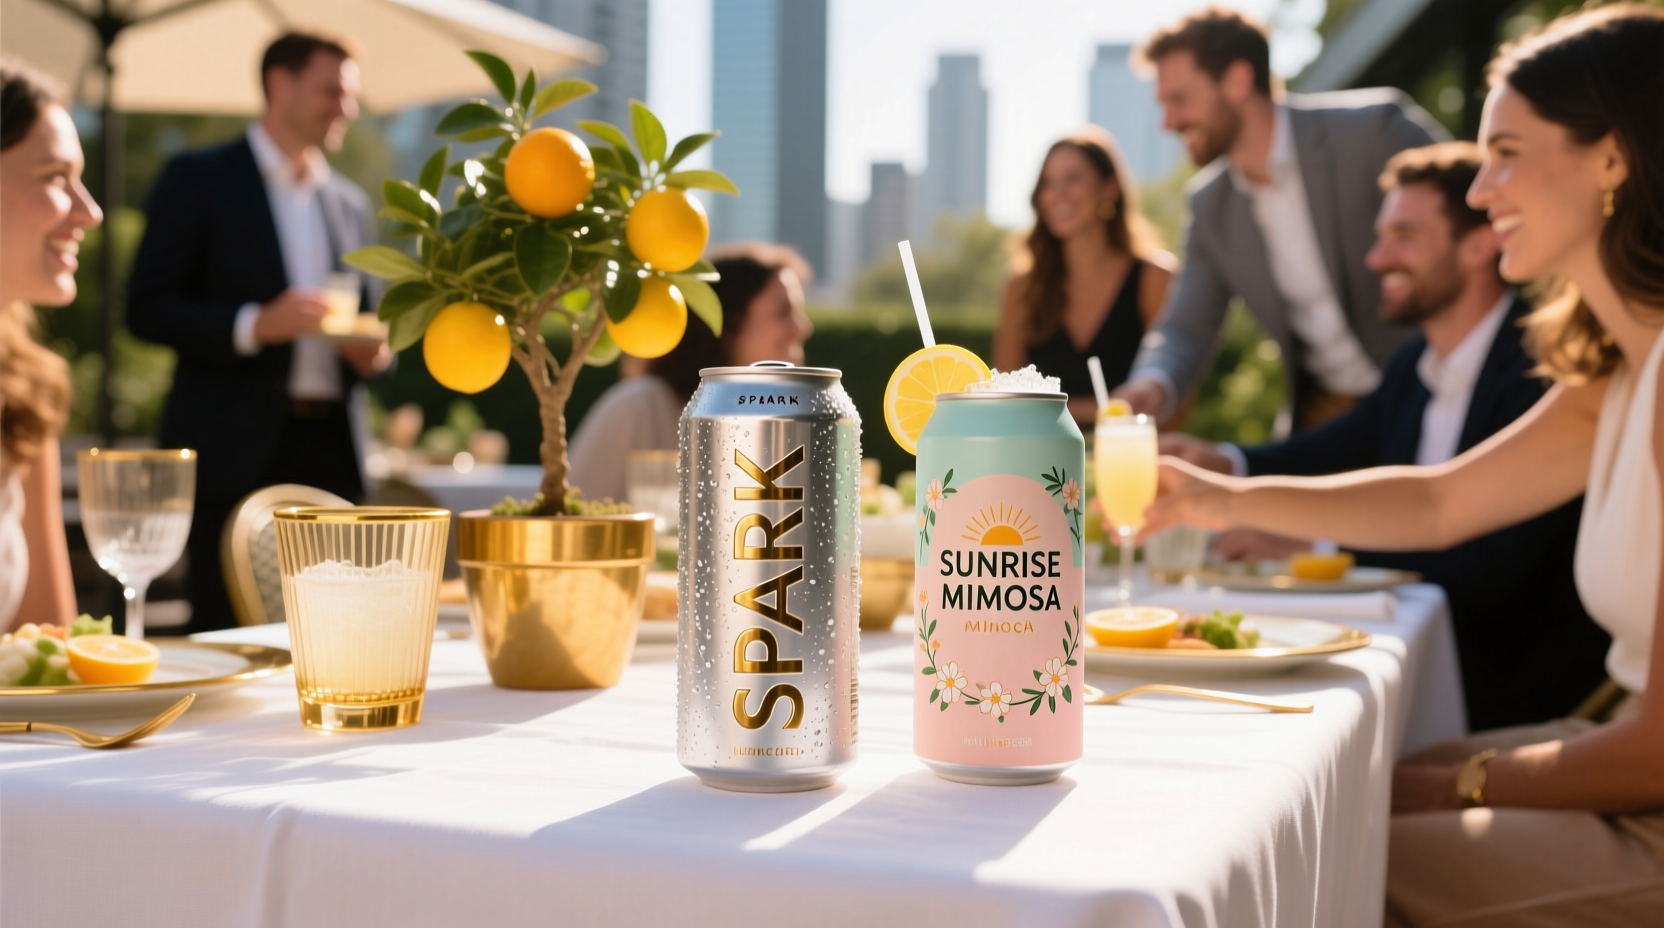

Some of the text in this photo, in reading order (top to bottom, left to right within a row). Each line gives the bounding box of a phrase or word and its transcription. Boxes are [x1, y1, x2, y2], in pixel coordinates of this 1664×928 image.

[940, 549, 1061, 578] SUNRISE
[733, 444, 804, 730] SPARK
[942, 583, 1061, 611] MIMOSA
